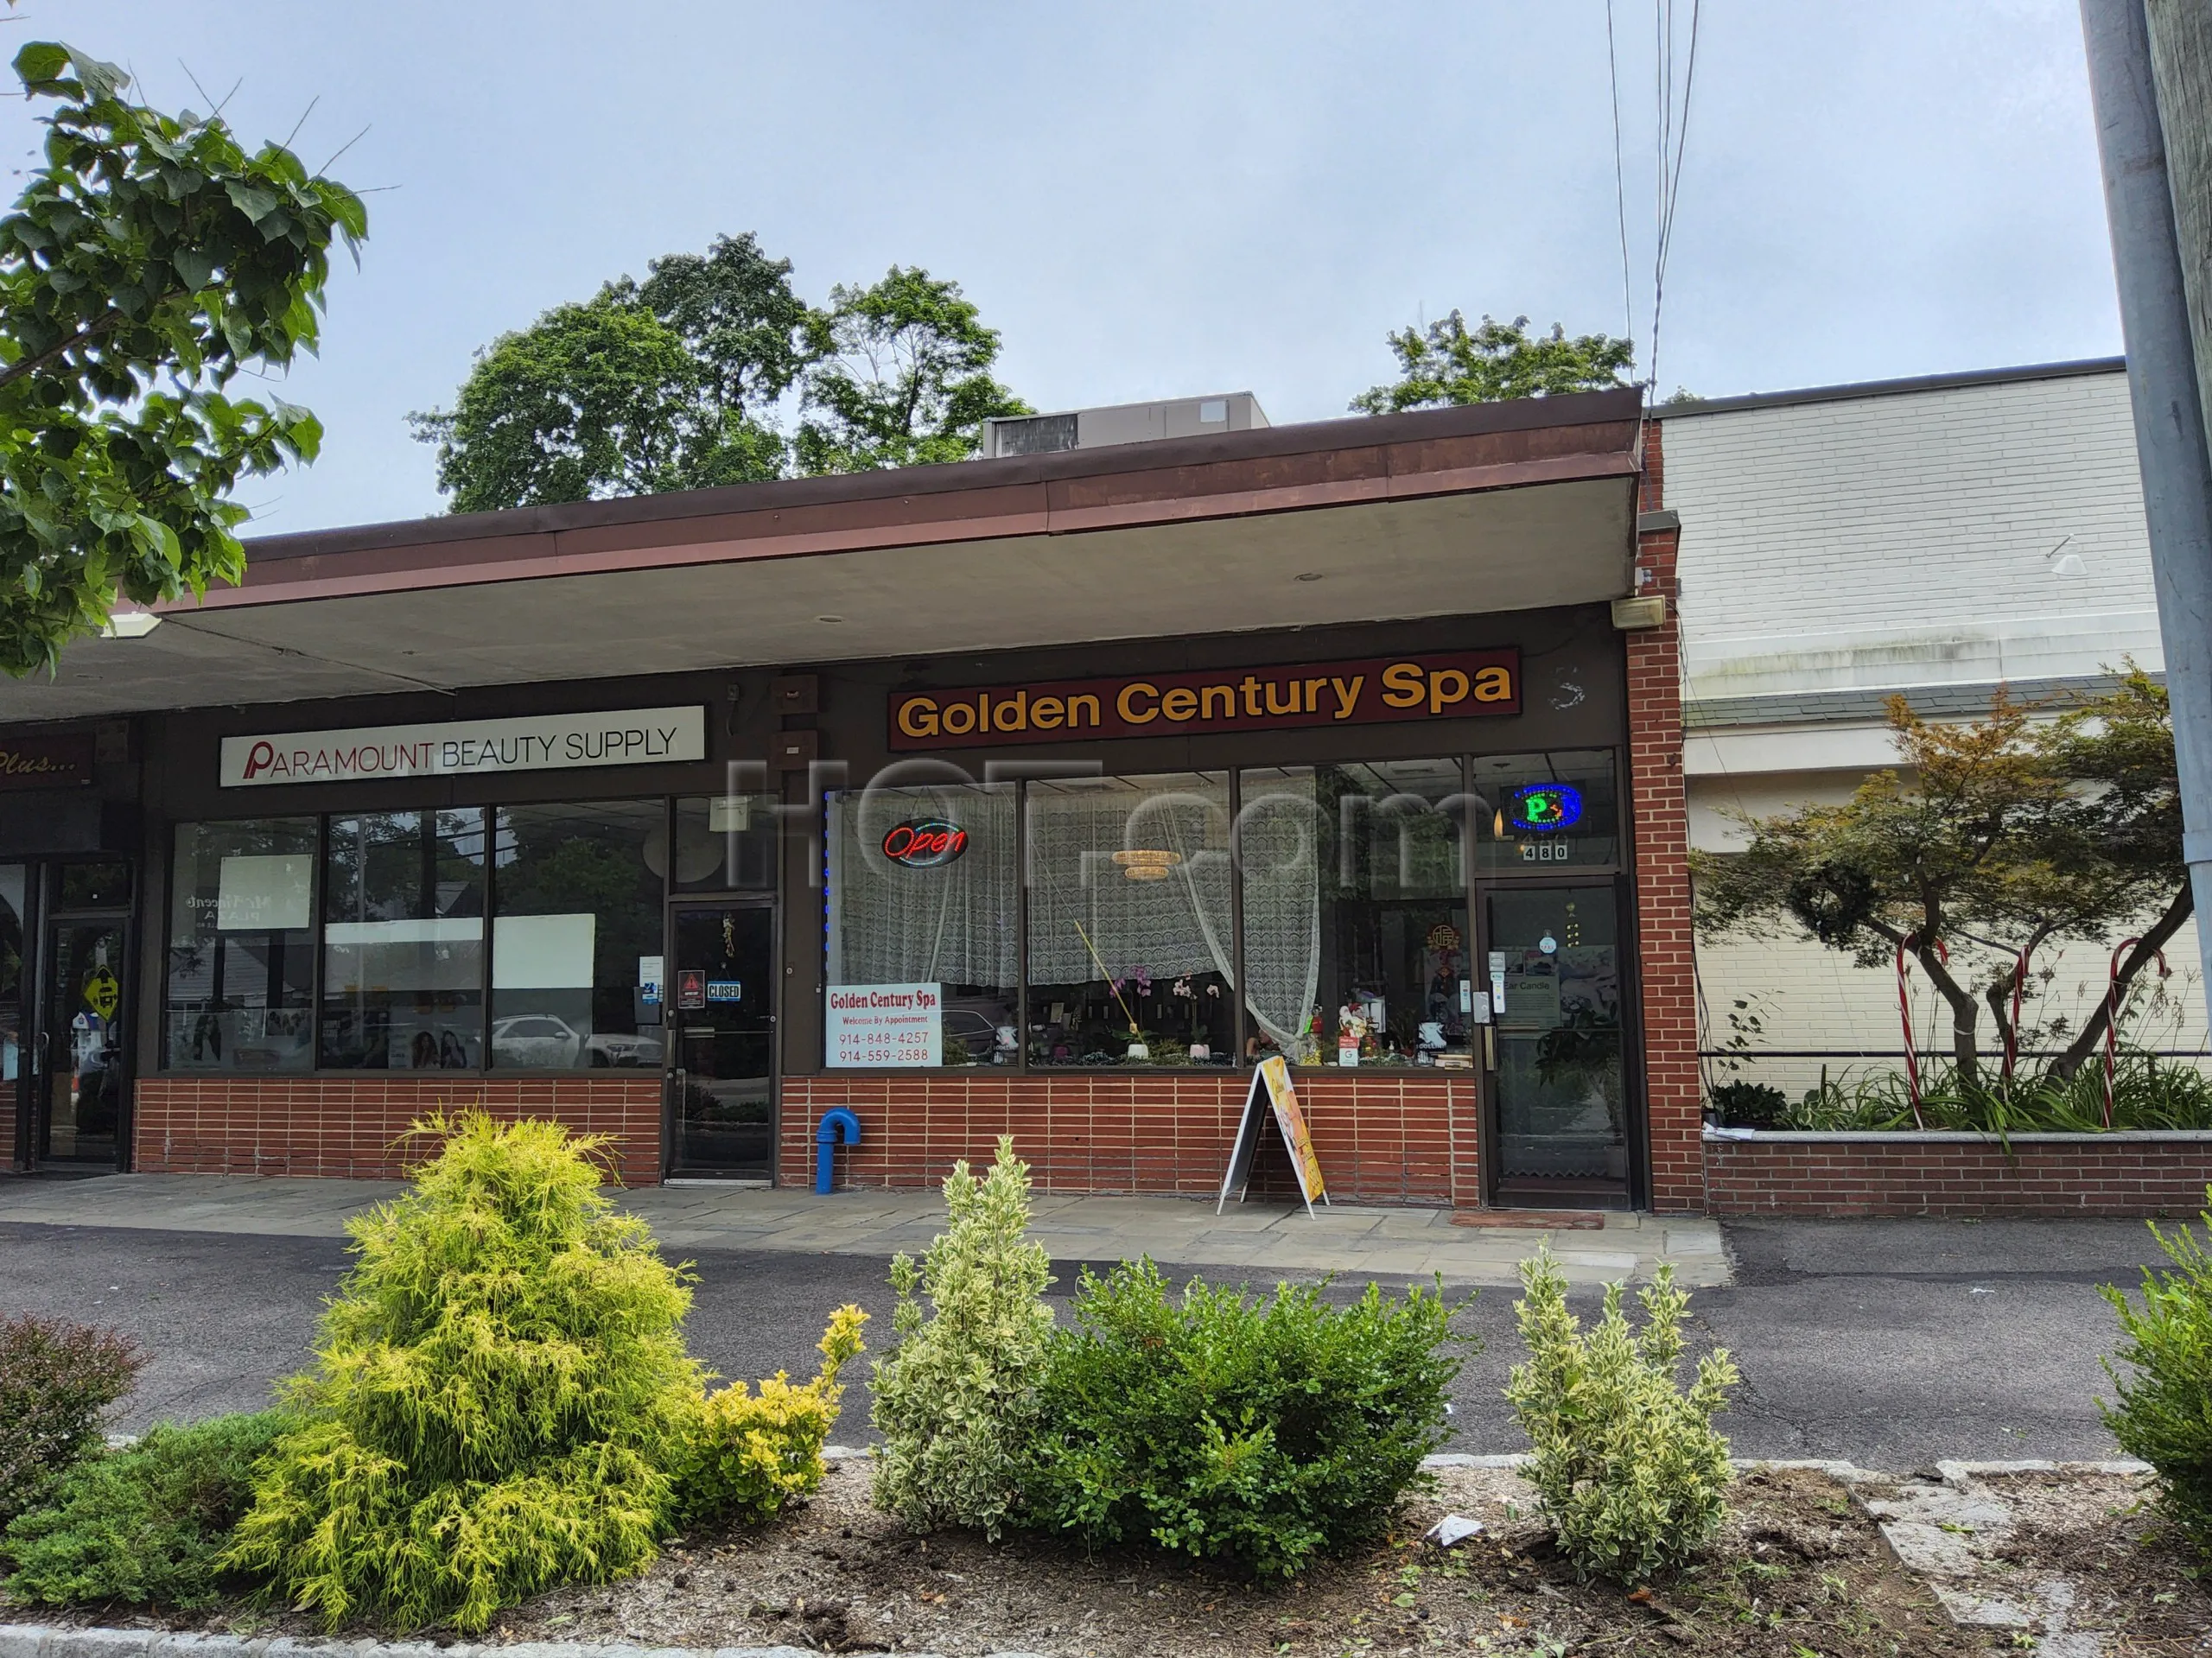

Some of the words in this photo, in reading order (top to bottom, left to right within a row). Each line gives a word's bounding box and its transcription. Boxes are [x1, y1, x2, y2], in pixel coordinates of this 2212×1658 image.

[897, 690, 1101, 738] Golden
[1116, 674, 1364, 724] Century
[1380, 663, 1513, 713] Spa
[242, 740, 435, 779] PARAMOUNT
[442, 734, 557, 768] BEAUTY
[565, 727, 677, 759] SUPPLY
[884, 827, 966, 859] Open
[1525, 848, 1565, 858] 480
[709, 985, 739, 997] CLOSED
[1520, 981, 1550, 990] Candle
[830, 993, 868, 1009] Golden
[870, 991, 914, 1010] Century
[916, 989, 936, 1010] Spa
[842, 1016, 872, 1025] Welcome
[874, 1016, 883, 1026] By
[885, 1014, 928, 1026] Appointment
[839, 1032, 929, 1045] 914-848-4257
[839, 1049, 929, 1062] 914-559-2588
